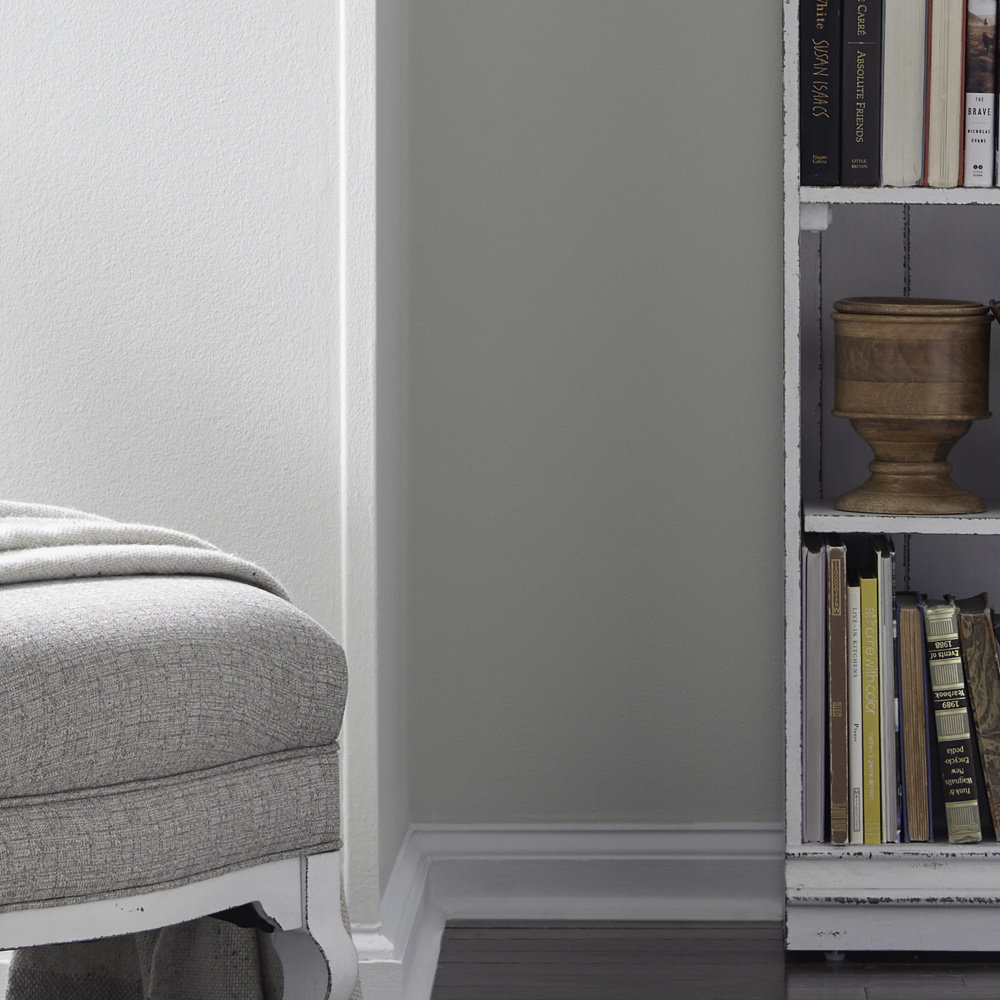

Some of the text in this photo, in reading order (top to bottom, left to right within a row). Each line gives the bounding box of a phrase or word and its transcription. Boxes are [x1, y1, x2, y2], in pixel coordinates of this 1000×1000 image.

[857, 4, 868, 36] CARRÉ
[812, 38, 831, 118] SUSAN ISAACS
[855, 51, 867, 143] ABSOLUTE FRIENDS
[967, 107, 991, 116] BRAVE
[934, 640, 953, 649] 1988
[929, 649, 960, 659] Events of
[864, 607, 878, 714] at home with color
[934, 689, 965, 699] Yearbook
[941, 700, 960, 709] 1989
[944, 776, 973, 786] Wagnalls
